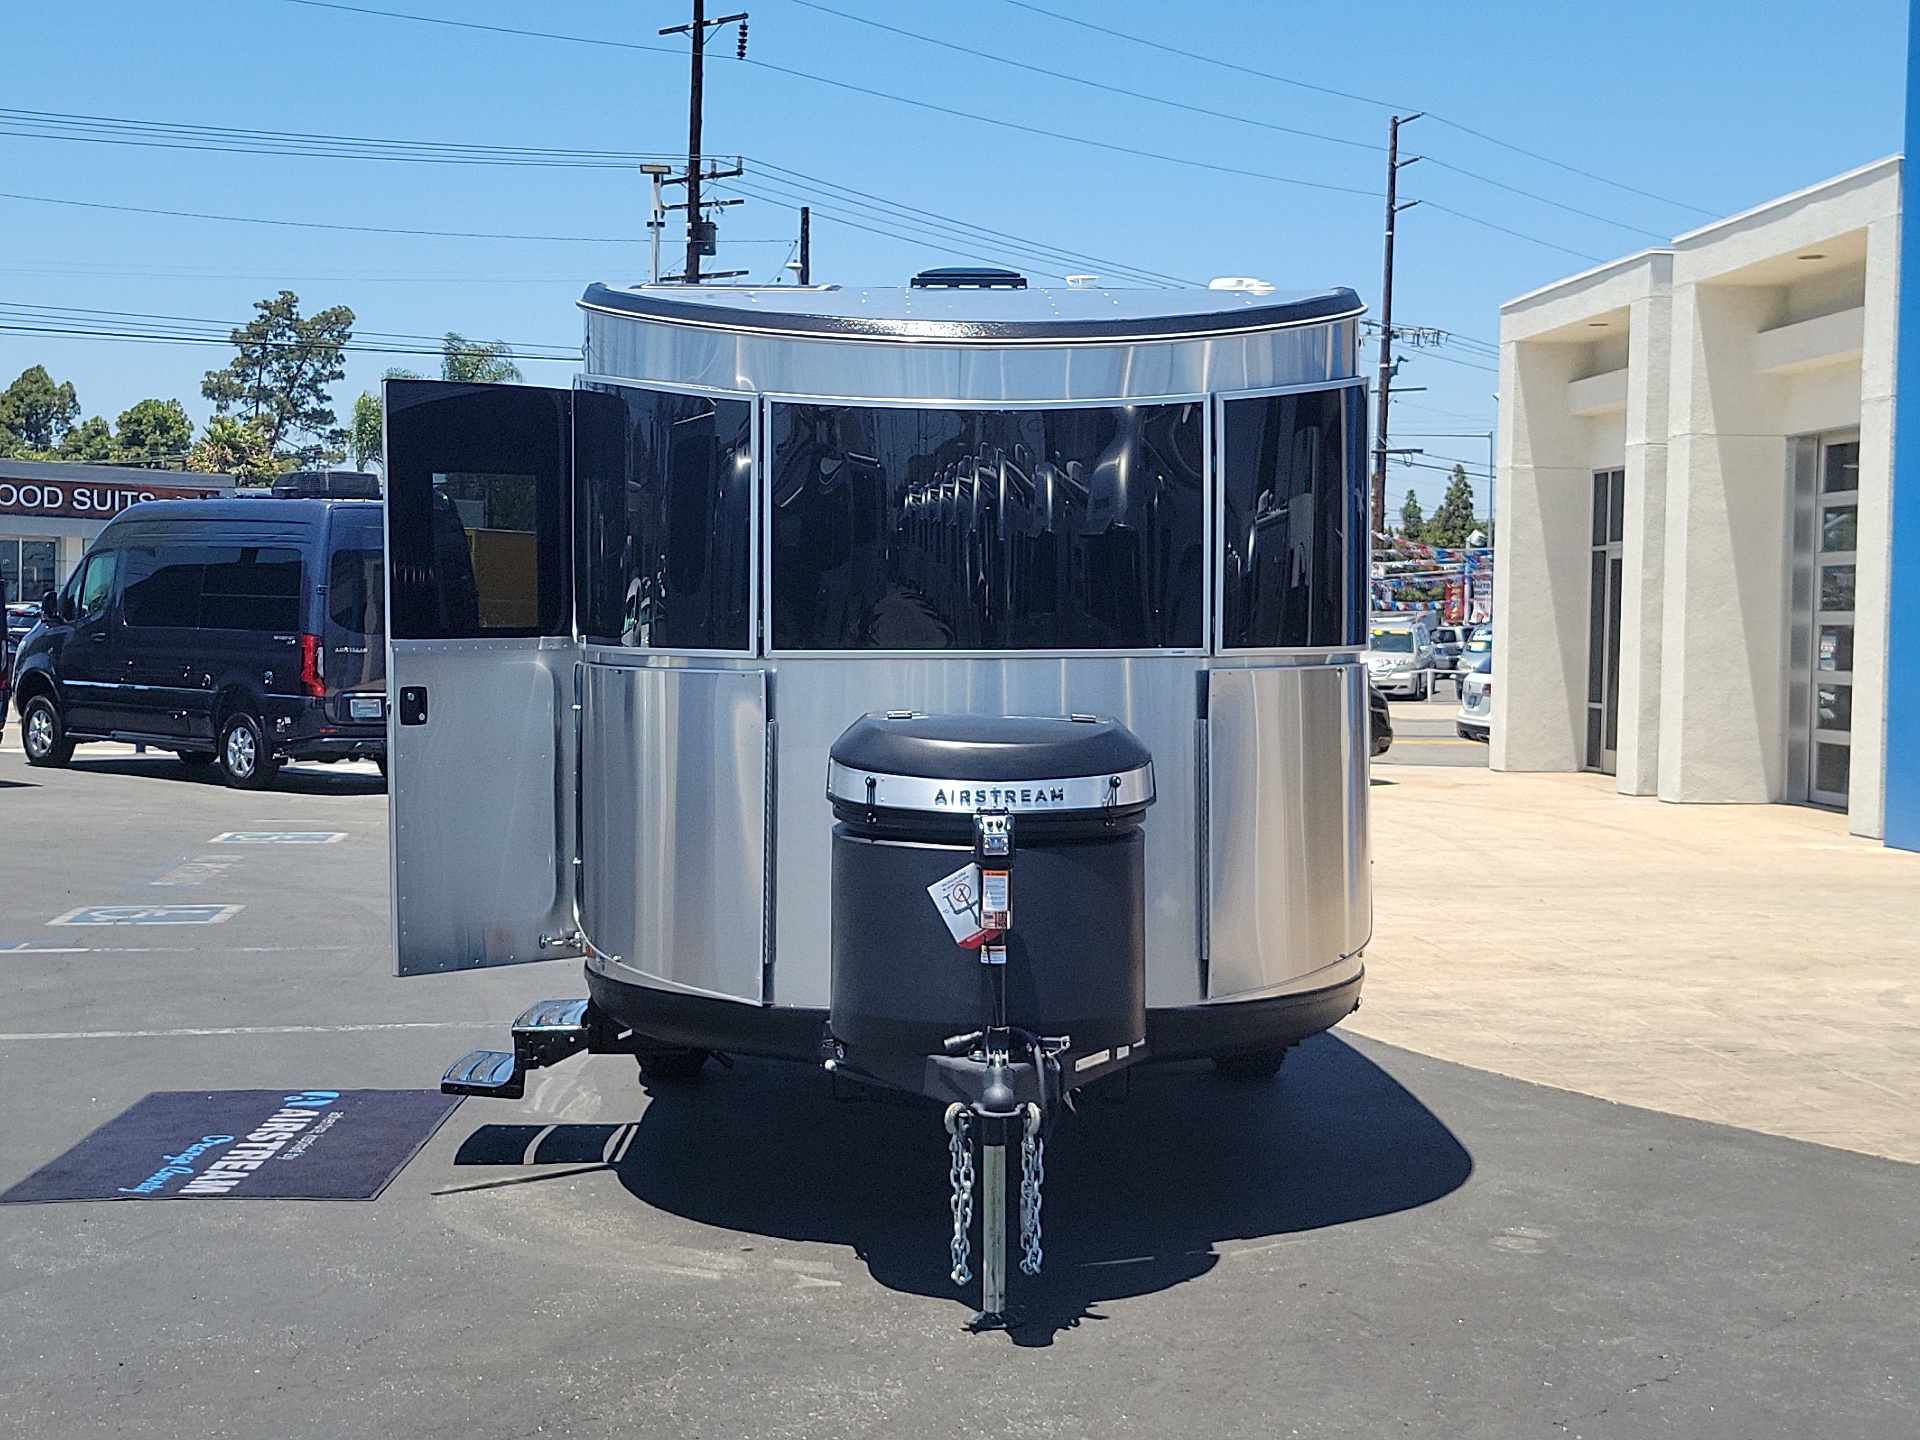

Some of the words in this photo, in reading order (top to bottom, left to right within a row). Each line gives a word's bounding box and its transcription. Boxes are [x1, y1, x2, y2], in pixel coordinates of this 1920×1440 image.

[934, 787, 1064, 806] AIRSTREAM
[163, 1134, 235, 1164] Orange
[178, 1108, 320, 1193] AIRSTREAM
[117, 1165, 194, 1193] County
